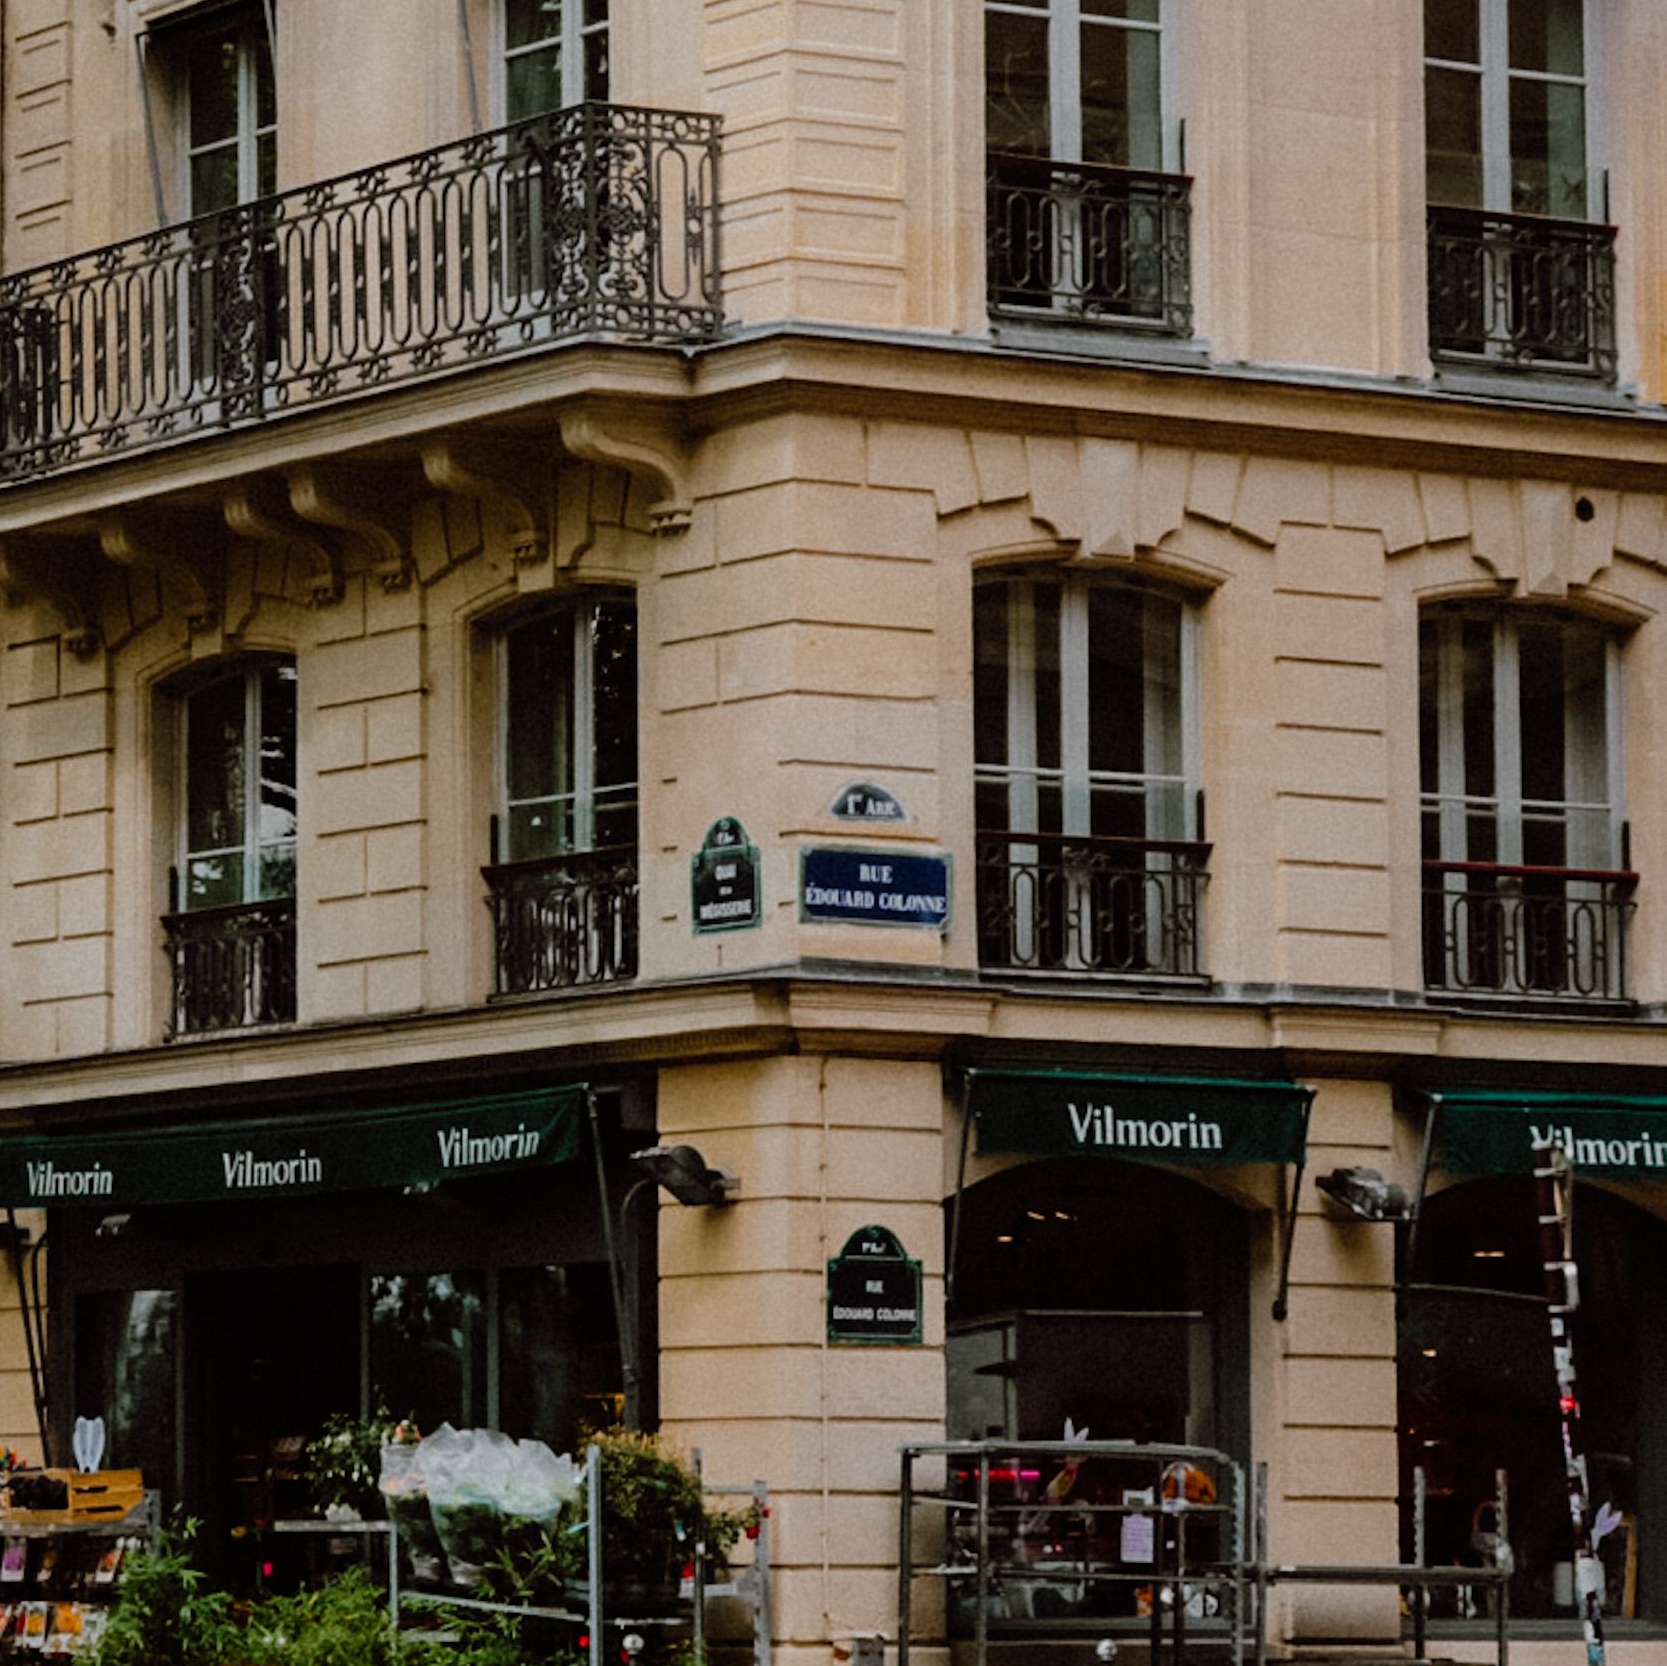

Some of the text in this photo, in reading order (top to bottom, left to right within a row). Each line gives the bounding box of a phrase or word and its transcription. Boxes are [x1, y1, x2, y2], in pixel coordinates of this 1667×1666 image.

[859, 863, 894, 884] RUE
[805, 882, 946, 914] ÉDOUARD COLONNE
[1068, 1102, 1222, 1149] Vilmorin
[437, 1122, 540, 1168] Vilmorin
[26, 1160, 113, 1196] Vilmorin
[222, 1148, 322, 1188] Vilmorin
